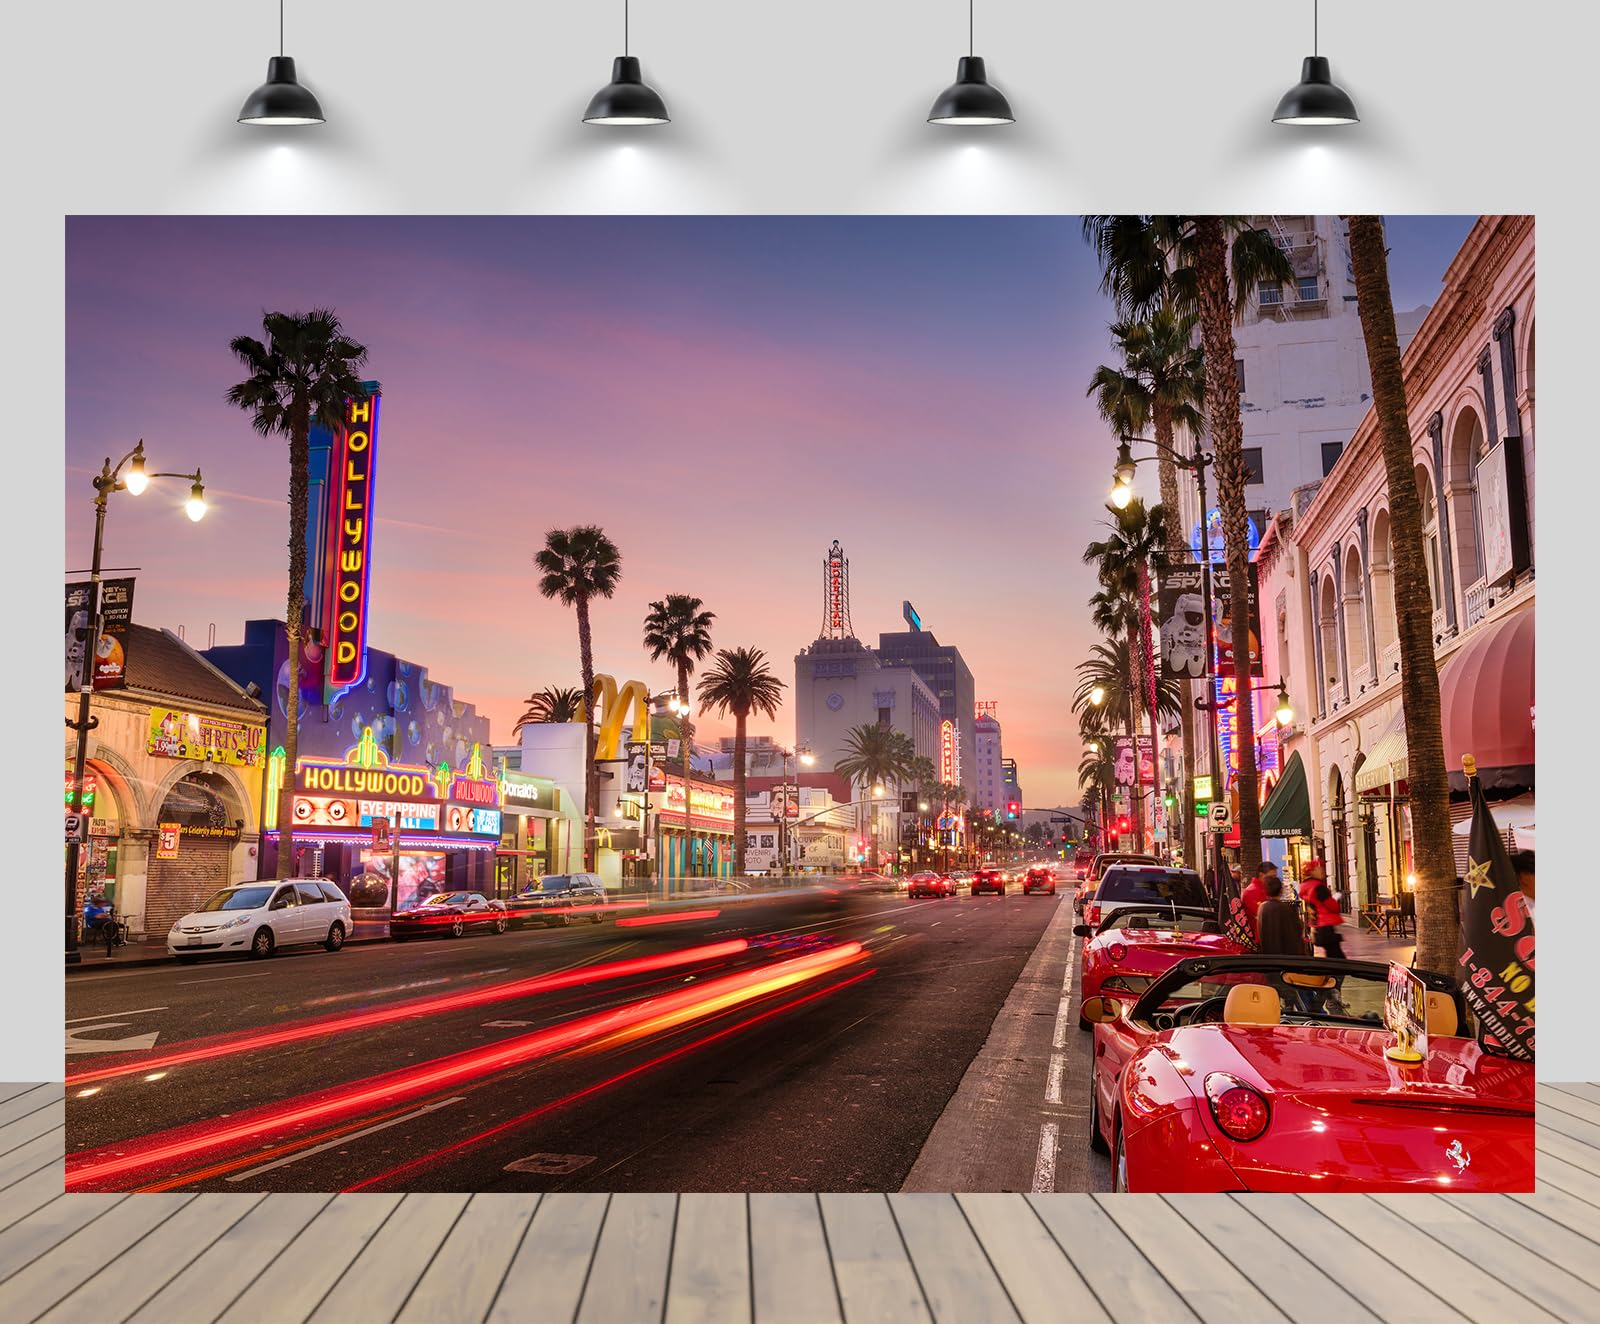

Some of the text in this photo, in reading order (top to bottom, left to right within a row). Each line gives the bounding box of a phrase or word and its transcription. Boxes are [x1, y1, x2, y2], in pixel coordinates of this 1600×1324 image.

[337, 401, 369, 664] HOLLYWOOD
[943, 734, 952, 781] CAPITA
[304, 767, 424, 796] HOLLYWOOD
[456, 780, 496, 804] HOLLYWOOD
[361, 801, 436, 818] EYE POPPING
[1498, 961, 1531, 994] NO
